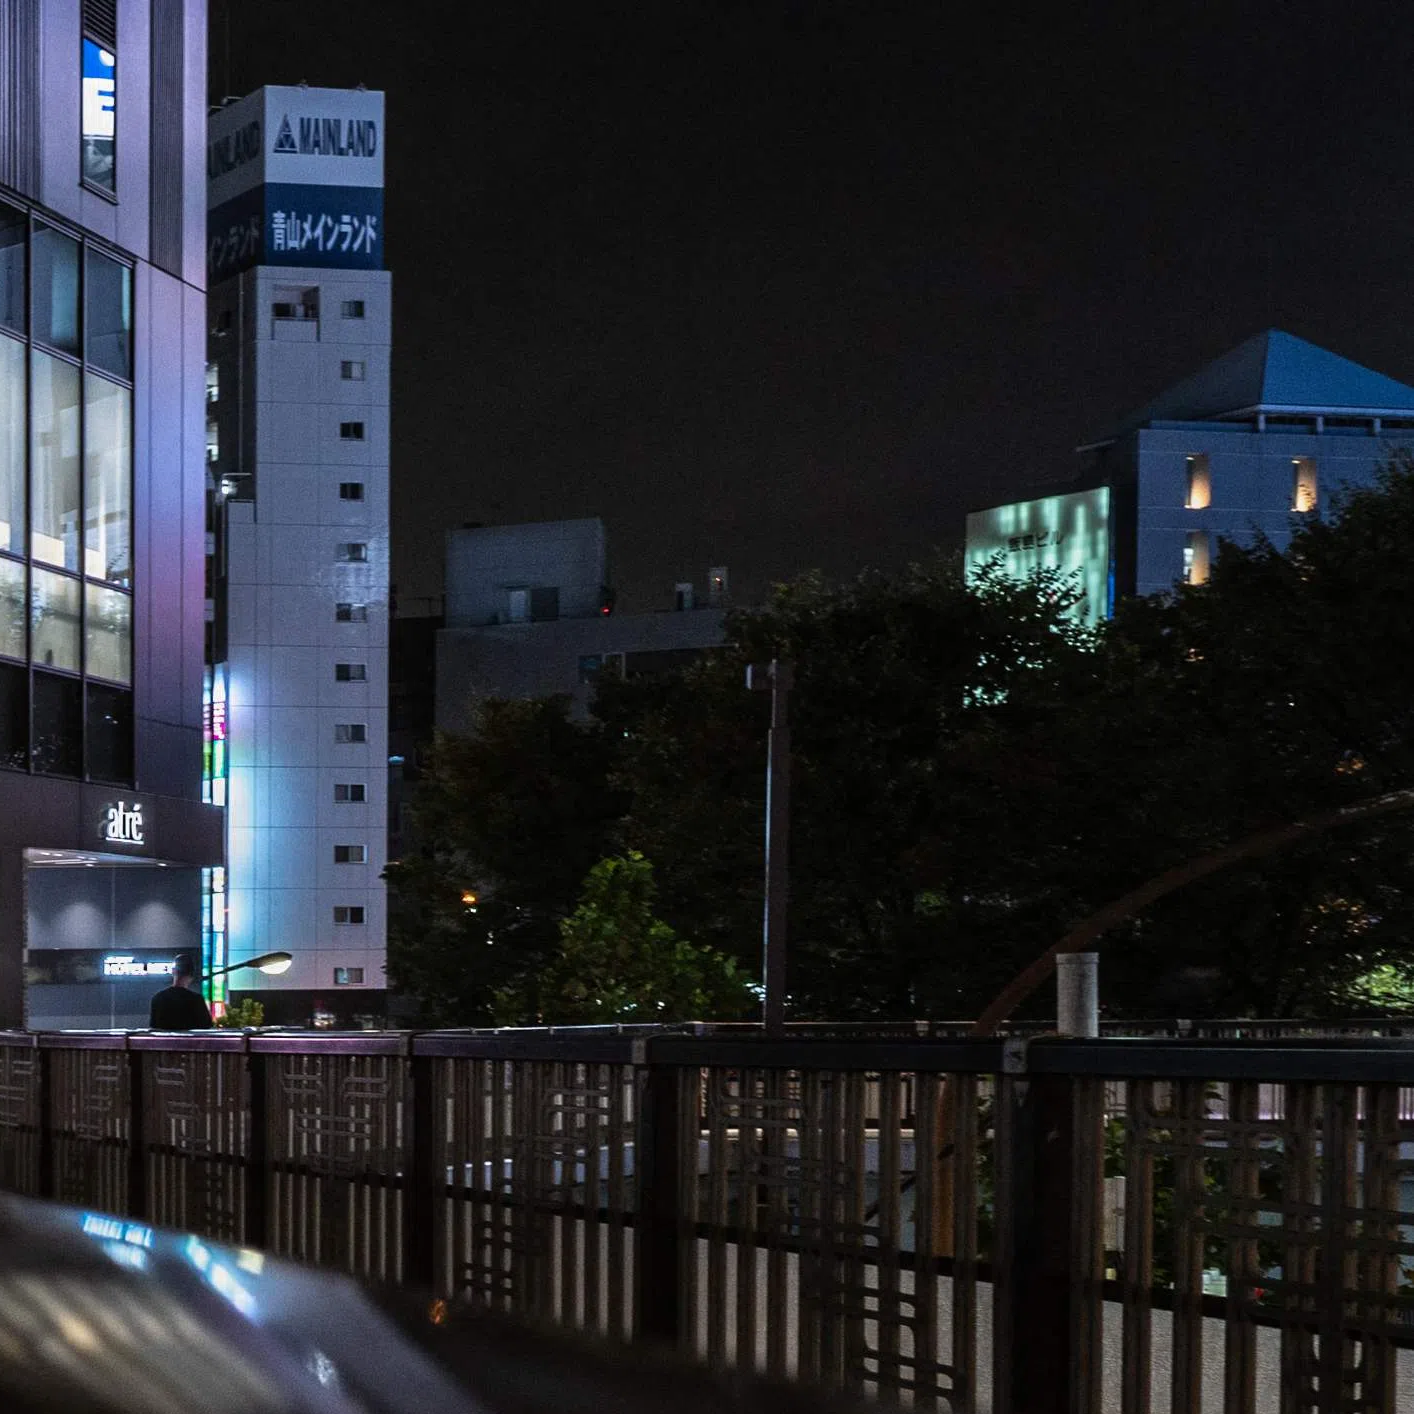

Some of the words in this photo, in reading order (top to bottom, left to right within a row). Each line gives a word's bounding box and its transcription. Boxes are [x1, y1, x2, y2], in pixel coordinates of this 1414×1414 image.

[299, 117, 377, 158] MAINLAND
[272, 210, 377, 254] 青山メインランド
